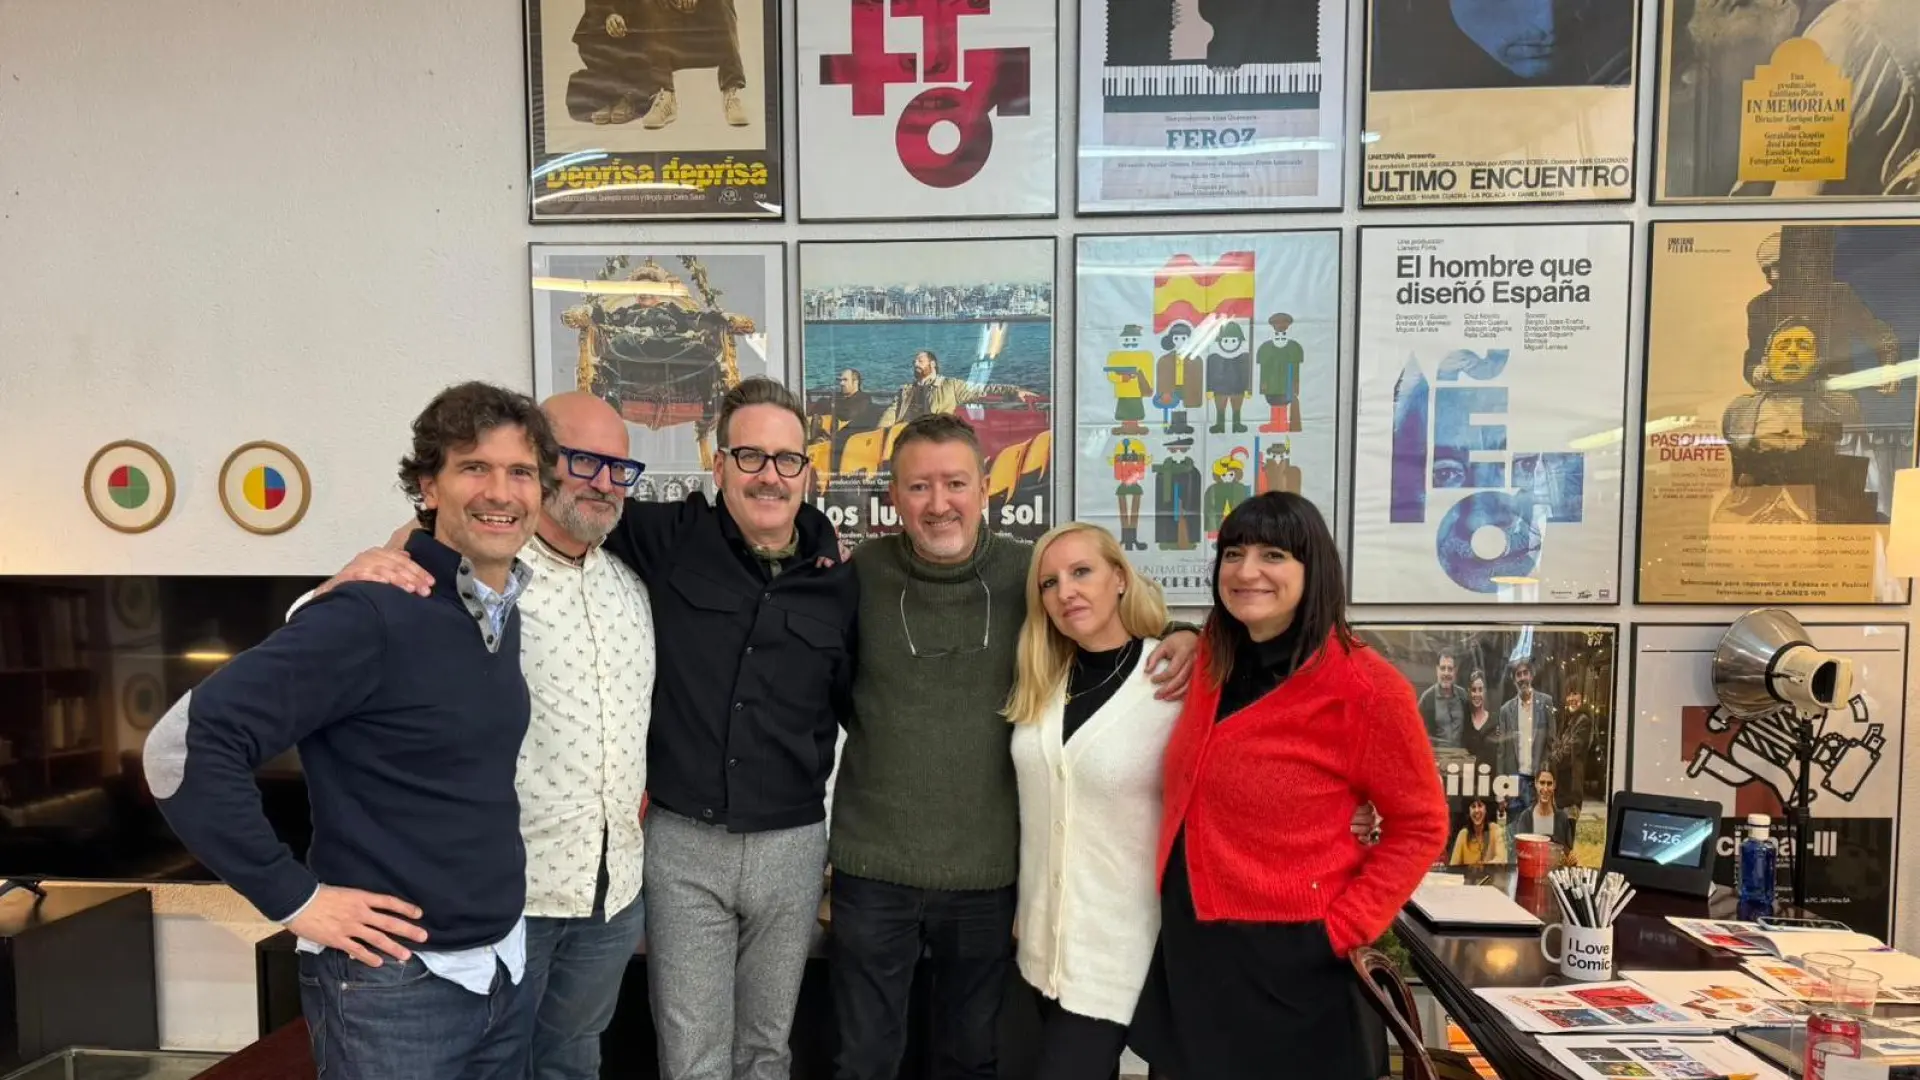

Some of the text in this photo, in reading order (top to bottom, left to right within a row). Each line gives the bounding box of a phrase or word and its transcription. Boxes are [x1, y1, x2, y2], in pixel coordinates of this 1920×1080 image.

[1747, 98, 1845, 113] IN MEMORIAM
[1166, 128, 1256, 149] FEROZ
[662, 156, 768, 191] deprisa
[1368, 165, 1629, 192] ULTIMO ENCUENTRO
[1397, 254, 1592, 282] El hombre que
[1396, 279, 1590, 308] diseñó España
[1660, 448, 1725, 461] DUARTE
[1001, 495, 1043, 525] sol
[1441, 763, 1519, 796] ilia
[1642, 830, 1682, 845] 14:26
[1568, 937, 1610, 955] I Love
